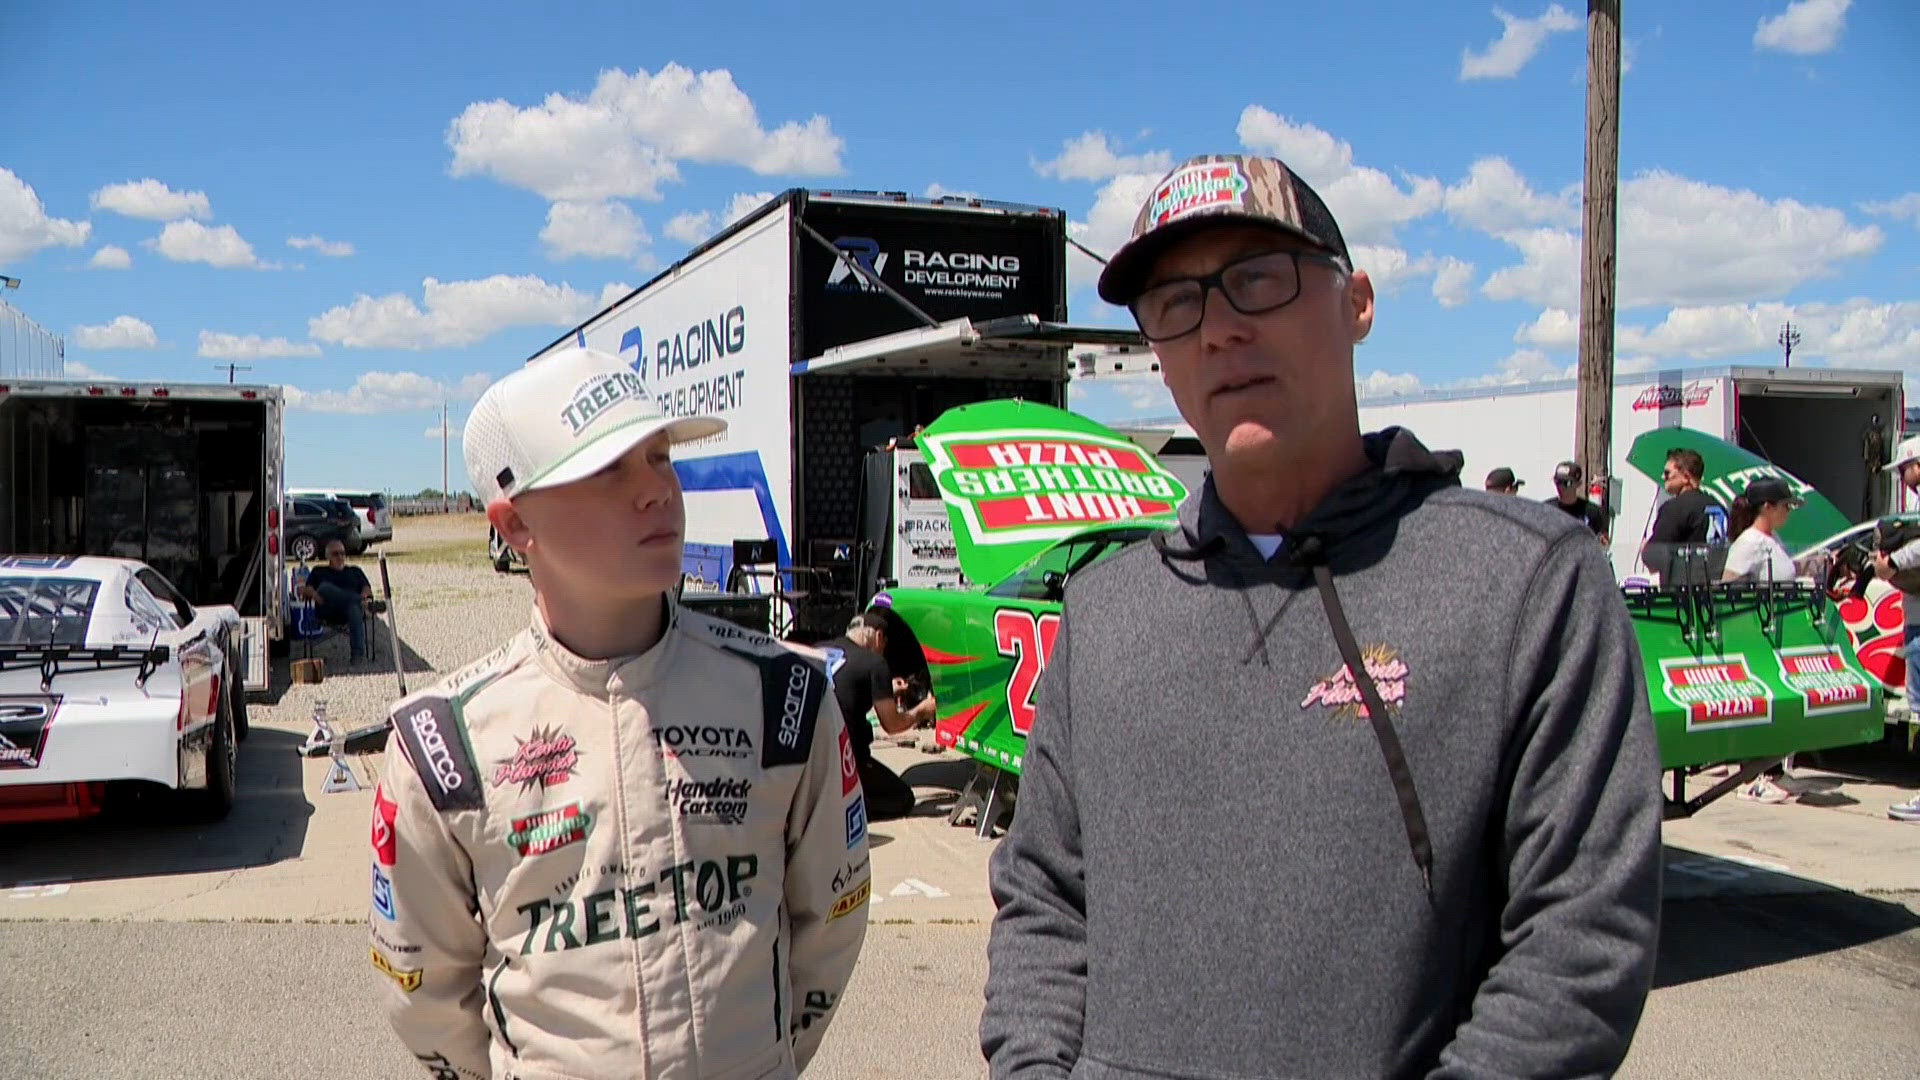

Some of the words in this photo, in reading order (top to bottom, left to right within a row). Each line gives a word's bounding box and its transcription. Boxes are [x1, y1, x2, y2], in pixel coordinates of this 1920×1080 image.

[904, 250, 1020, 272] RACING
[904, 269, 1020, 290] DEVELOPMENT
[656, 305, 746, 381] RACING
[986, 443, 1120, 469] PIZZA
[951, 468, 1175, 497] BROTHERS
[1024, 494, 1144, 521] HUNT
[1683, 666, 1732, 685] HUNT
[1794, 656, 1833, 673] HUNT
[1674, 681, 1763, 702] BROTHERS
[1818, 685, 1858, 703] PIZZA
[778, 663, 807, 746] sparco
[1704, 697, 1754, 717] PIZZA
[651, 725, 753, 748] TOYOTA
[411, 708, 462, 790] sparco
[665, 777, 752, 806] Hendrick
[679, 800, 748, 820] Cars.com
[718, 902, 746, 926] 1960
